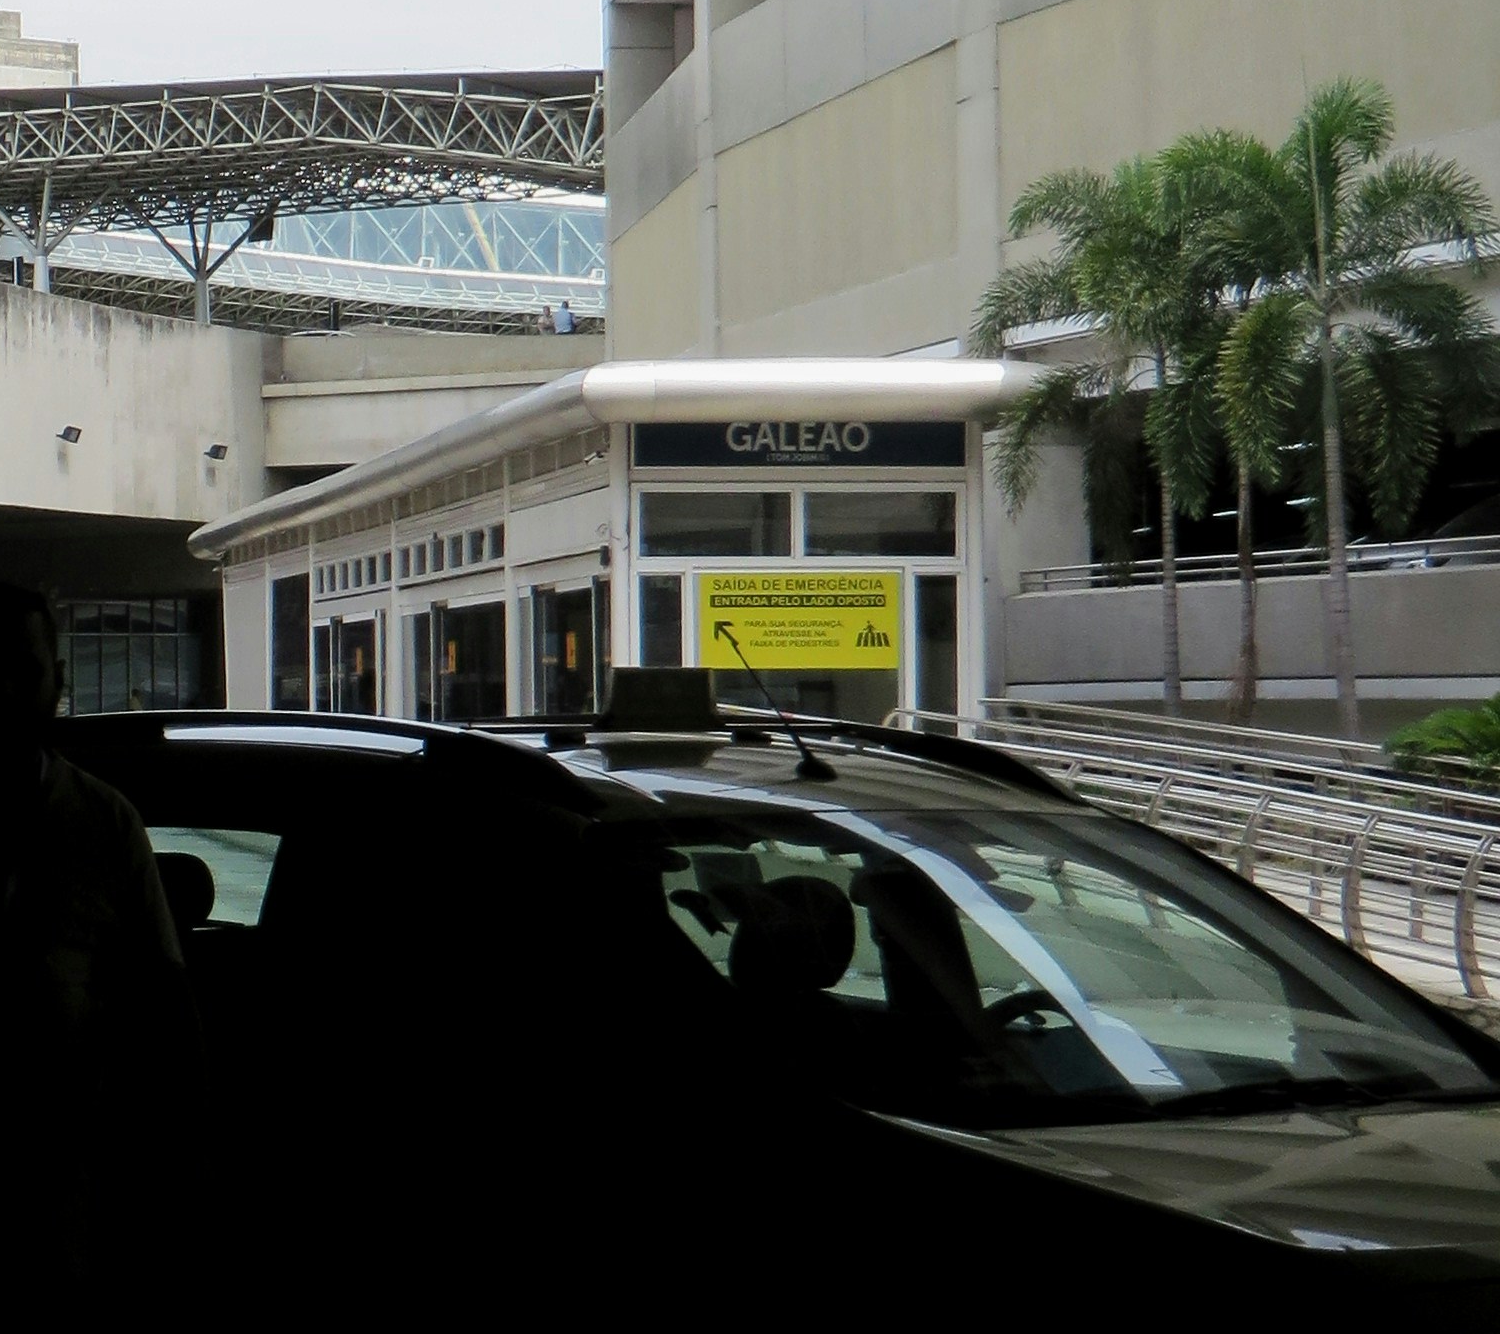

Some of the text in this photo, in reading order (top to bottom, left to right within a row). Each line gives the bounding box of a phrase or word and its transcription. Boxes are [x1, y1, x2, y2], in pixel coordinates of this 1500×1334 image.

[713, 576, 884, 591] SAÍDA DE EMERGÊNCIA
[714, 596, 886, 607] ENTRADA PELO LADO OPOSTO
[744, 620, 767, 628] PARA
[769, 620, 786, 628] SUA
[763, 629, 827, 638] ATRAVESSE NA
[749, 639, 840, 647] FAIXA DE PEDESTRES
